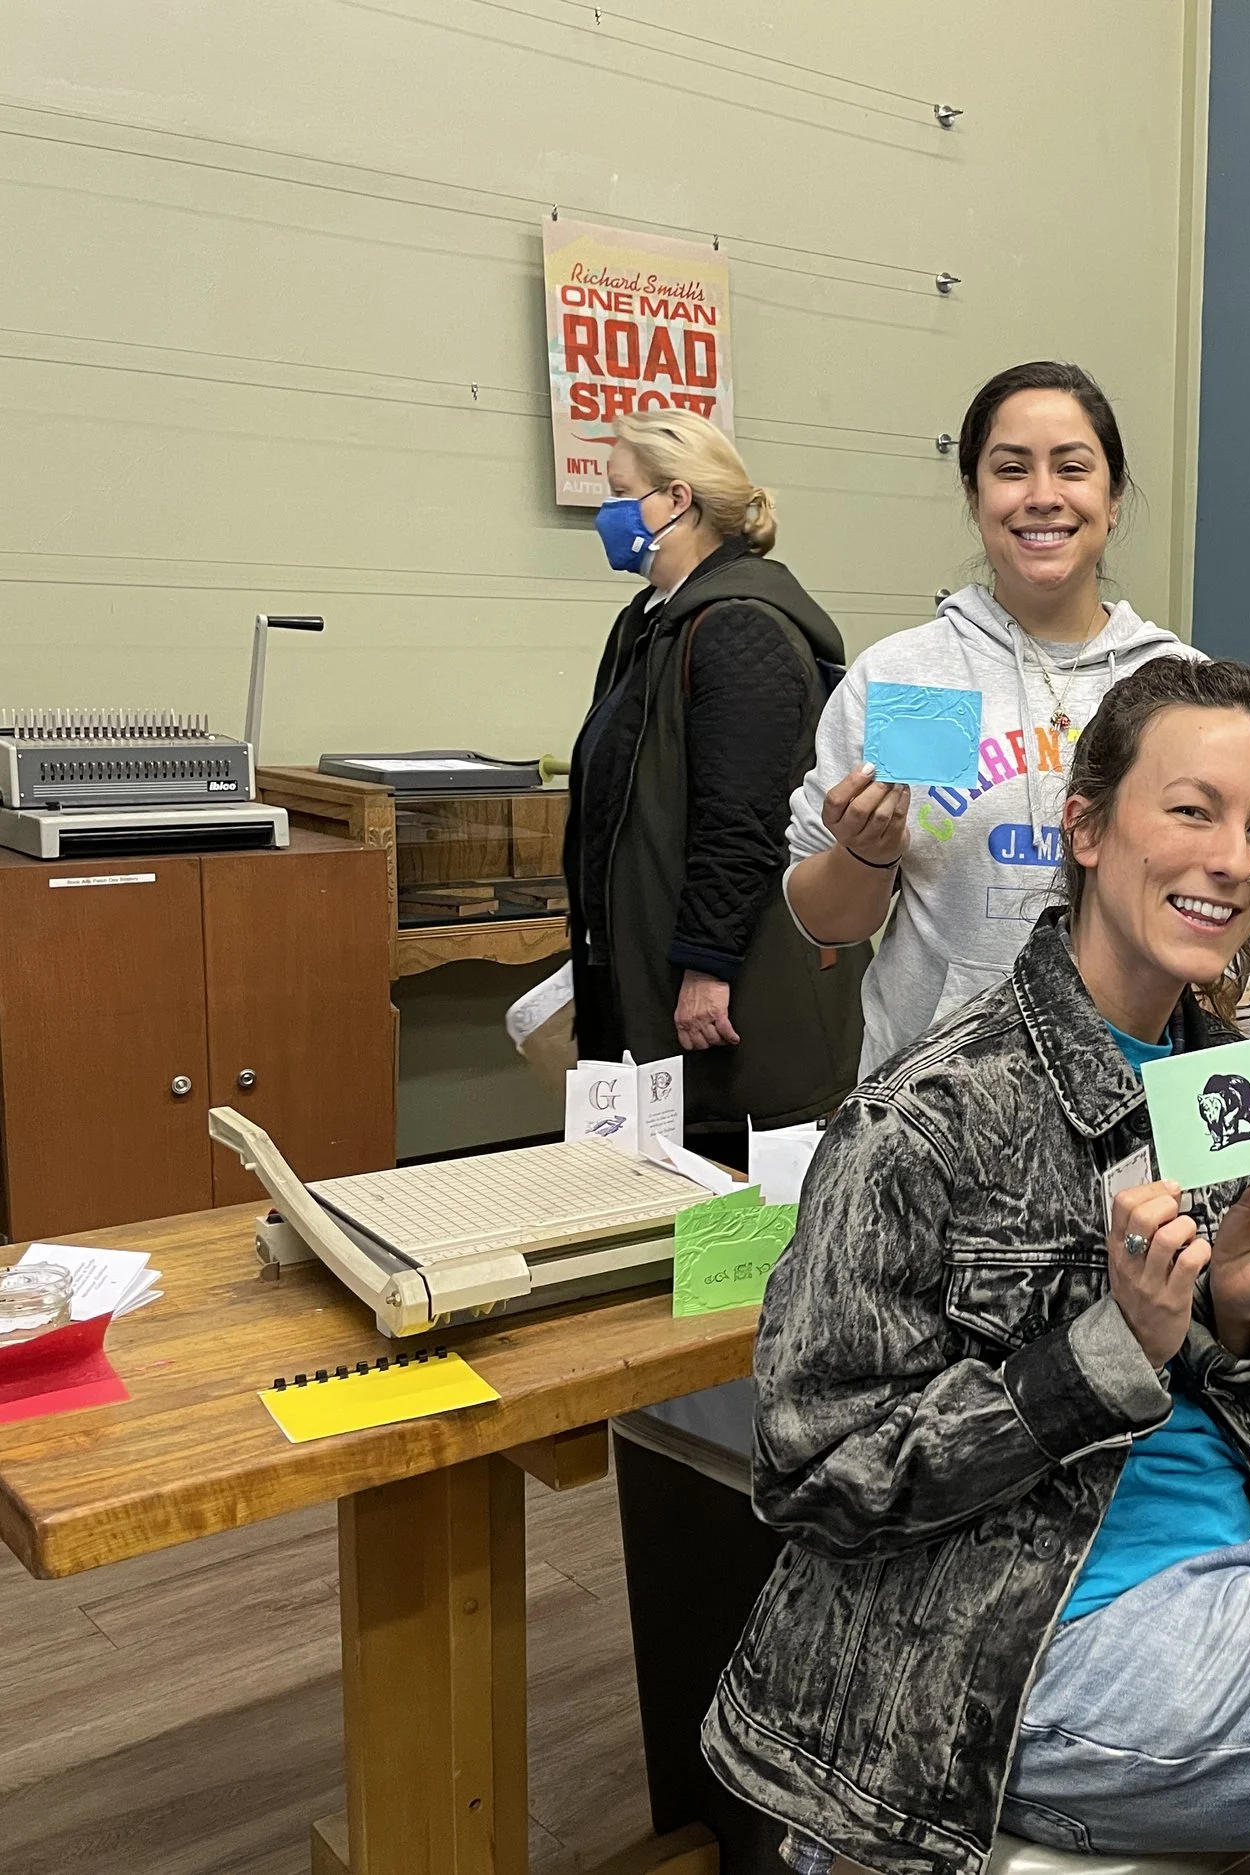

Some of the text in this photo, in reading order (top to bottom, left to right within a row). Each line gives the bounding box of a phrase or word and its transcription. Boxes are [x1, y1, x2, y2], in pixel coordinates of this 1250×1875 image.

[571, 262, 706, 301] Richard Smith's
[561, 285, 716, 325] ONE MAN
[563, 313, 716, 389] ROAD
[567, 457, 602, 475] INT'L
[918, 727, 1082, 842] CUREN
[1001, 830, 1064, 861] J. MA
[588, 1079, 621, 1110] G
